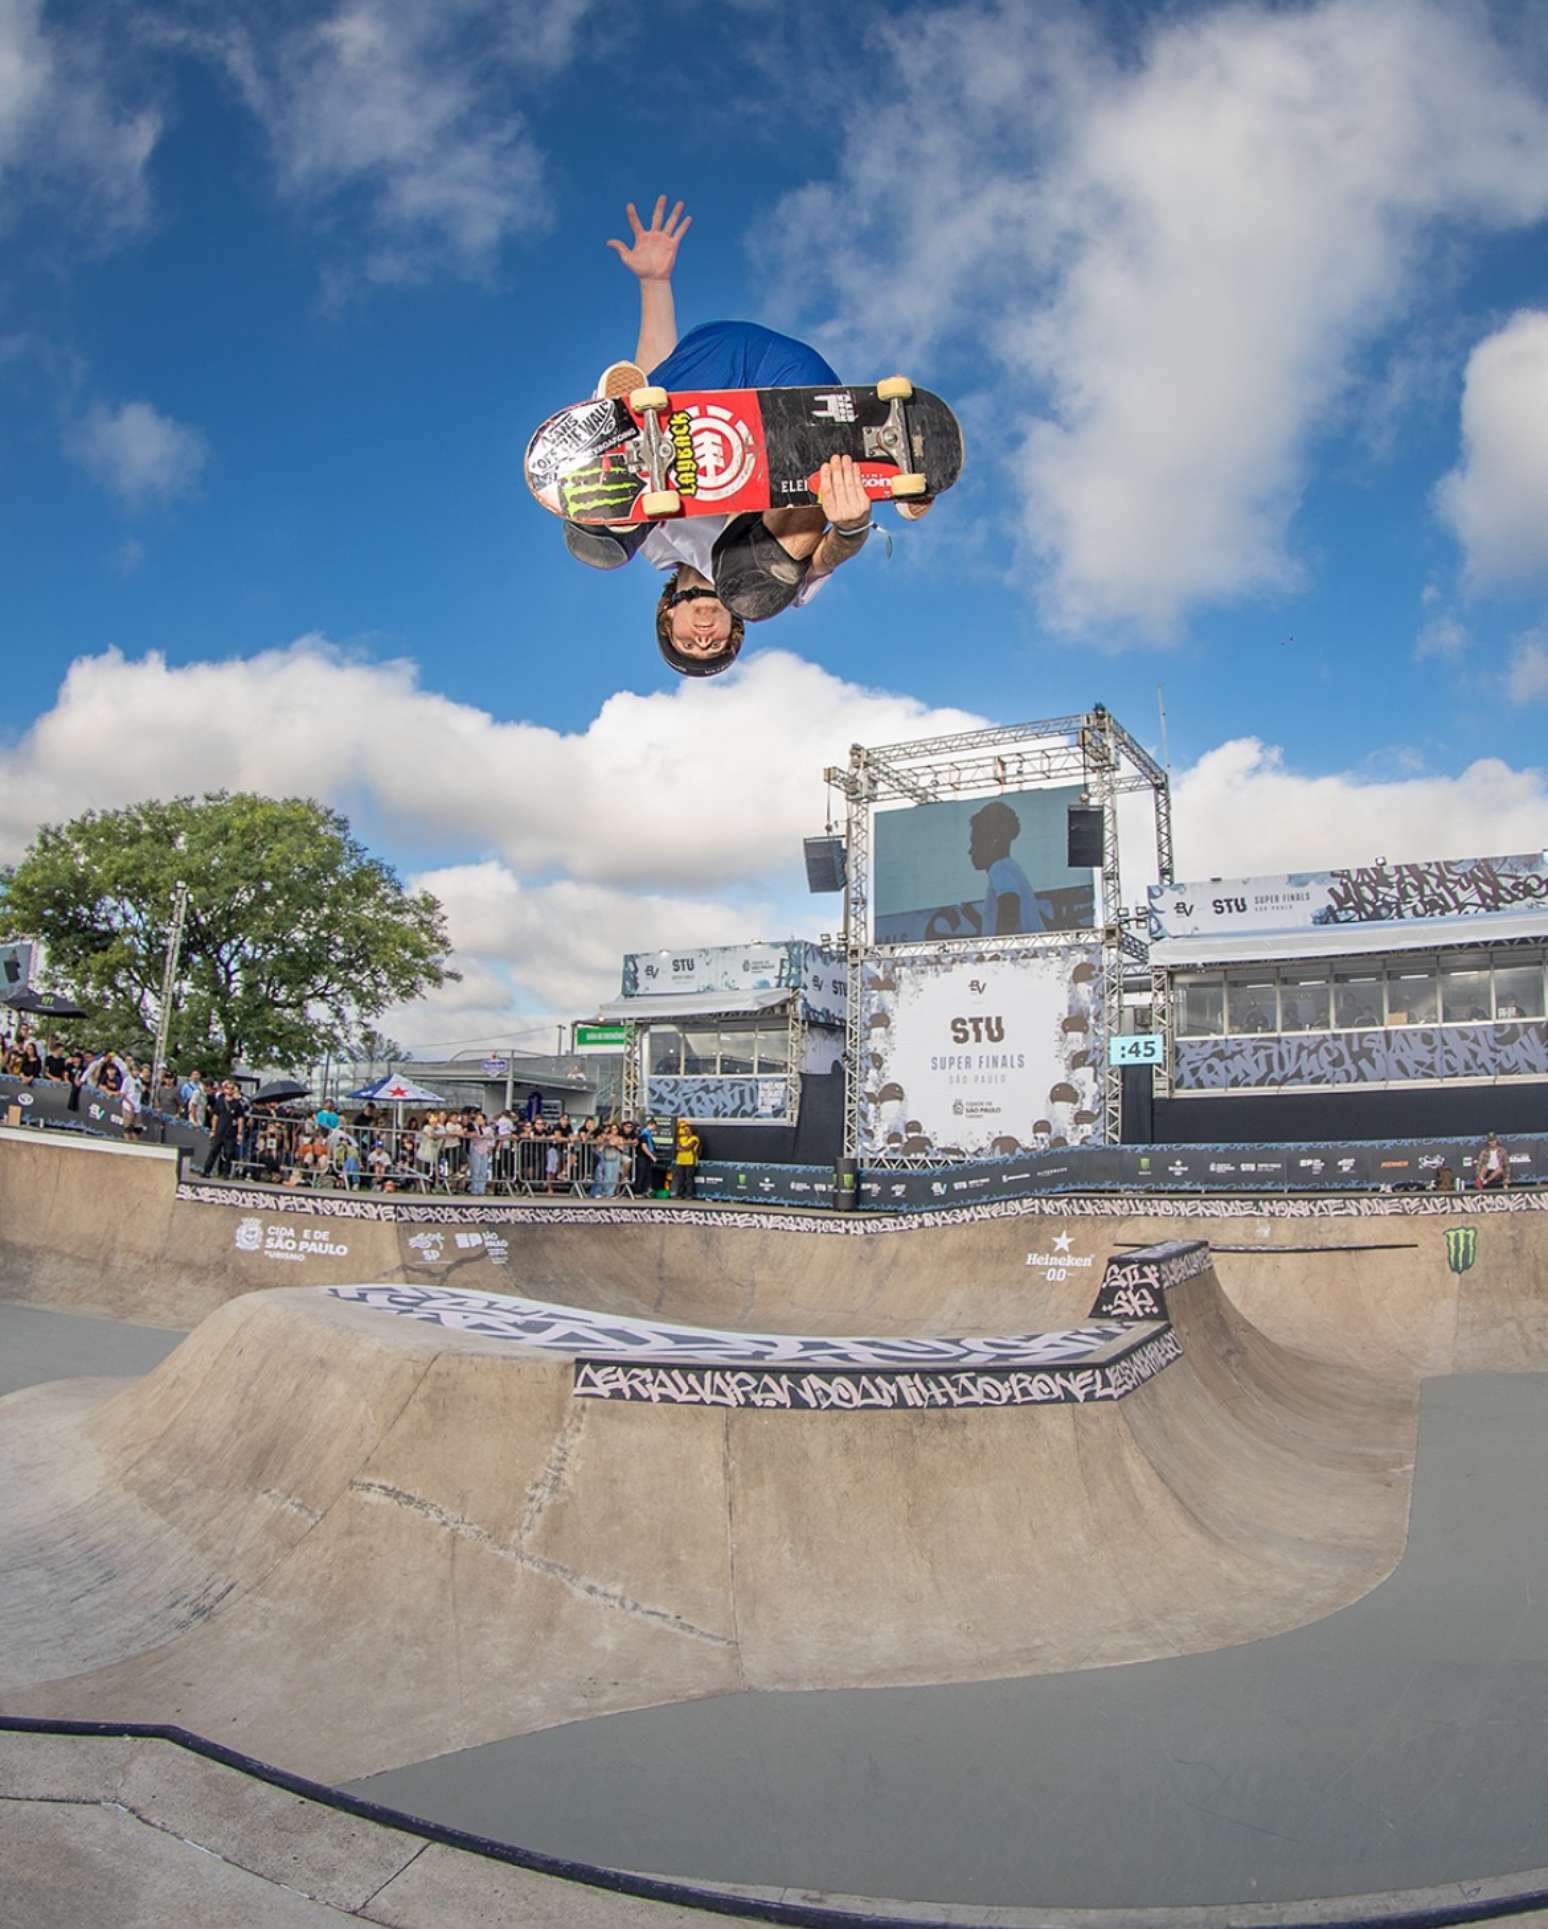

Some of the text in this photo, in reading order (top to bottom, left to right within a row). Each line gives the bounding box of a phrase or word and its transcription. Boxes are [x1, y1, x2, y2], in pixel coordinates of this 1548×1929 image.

[670, 411, 697, 496] LAYBACK
[781, 480, 808, 493] ELE
[1212, 897, 1247, 914] STU
[672, 959, 695, 972] STU
[951, 1016, 1005, 1044] STU
[1120, 1040, 1156, 1058] :45
[931, 1054, 1025, 1071] SUPER FINALS
[313, 1231, 330, 1242] DE
[265, 1235, 348, 1256] SÃO PAULO
[1025, 1253, 1093, 1268] Heineken
